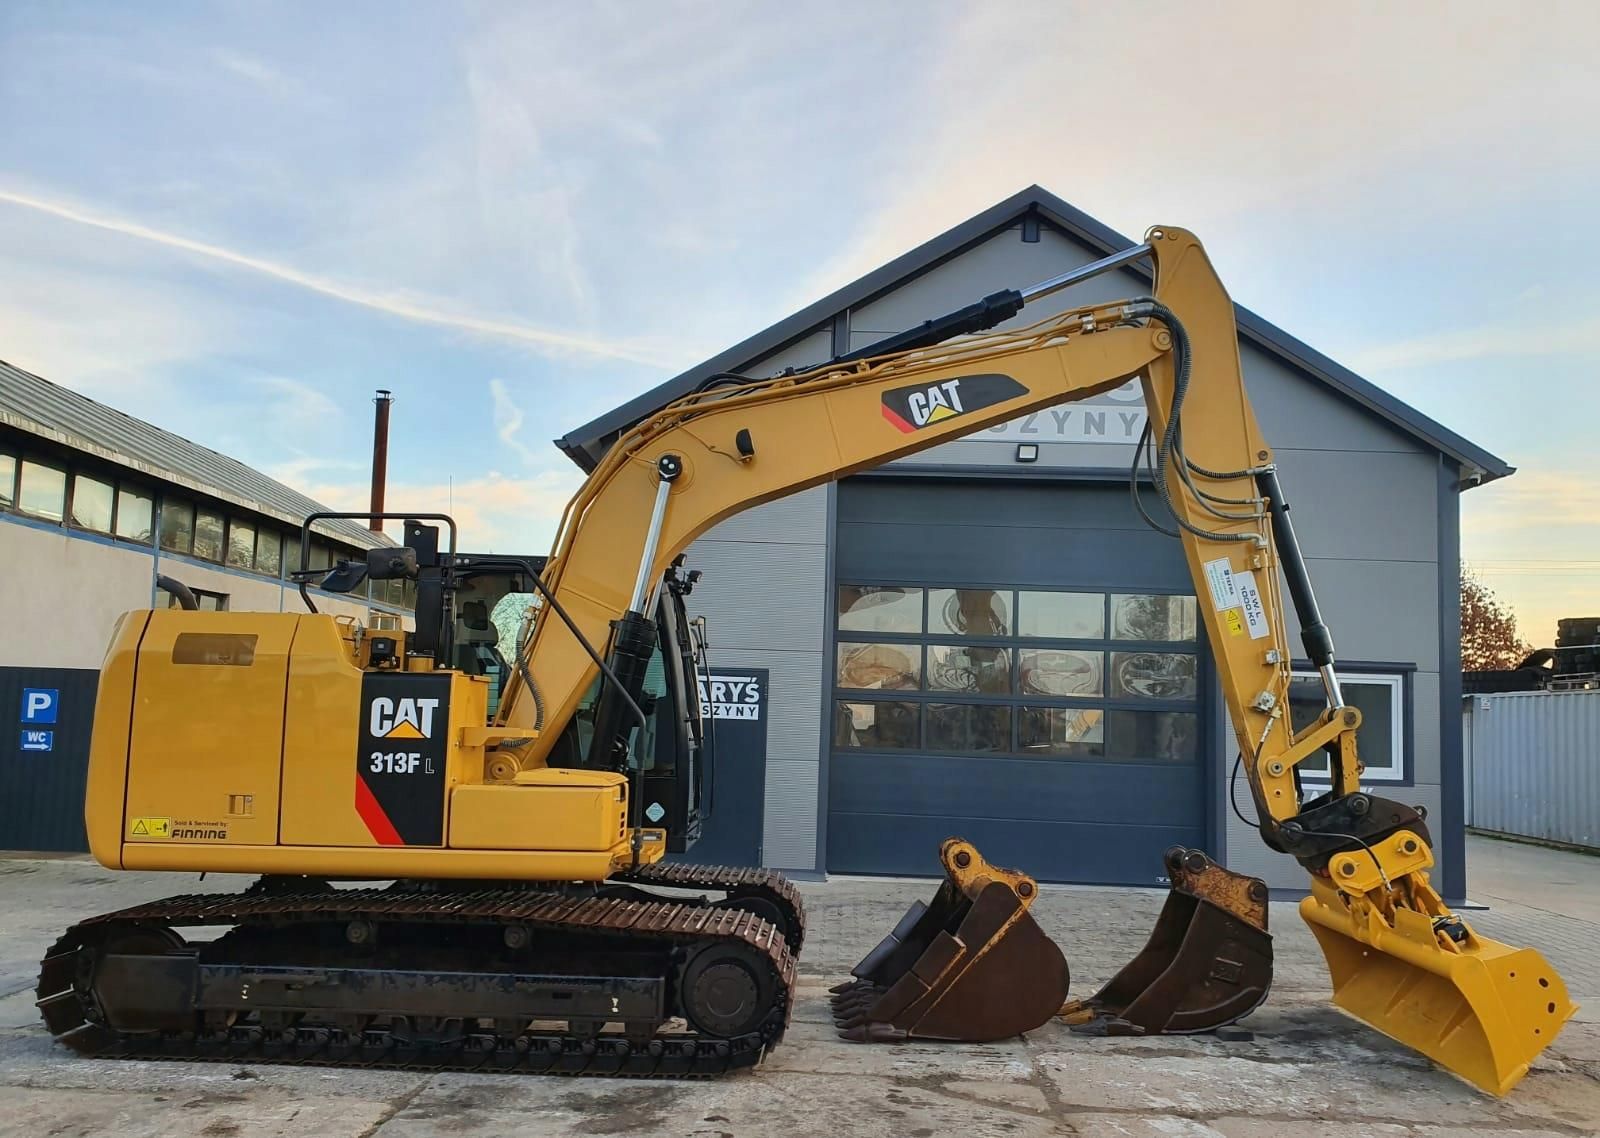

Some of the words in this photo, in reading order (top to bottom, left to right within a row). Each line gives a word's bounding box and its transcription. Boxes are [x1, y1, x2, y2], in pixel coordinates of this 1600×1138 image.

[908, 379, 963, 426] CAT
[27, 693, 51, 718] P
[370, 697, 439, 738] CAT
[28, 731, 46, 743] WC
[370, 752, 420, 773] 313F
[425, 758, 435, 774] L
[172, 829, 227, 839] FINNING
